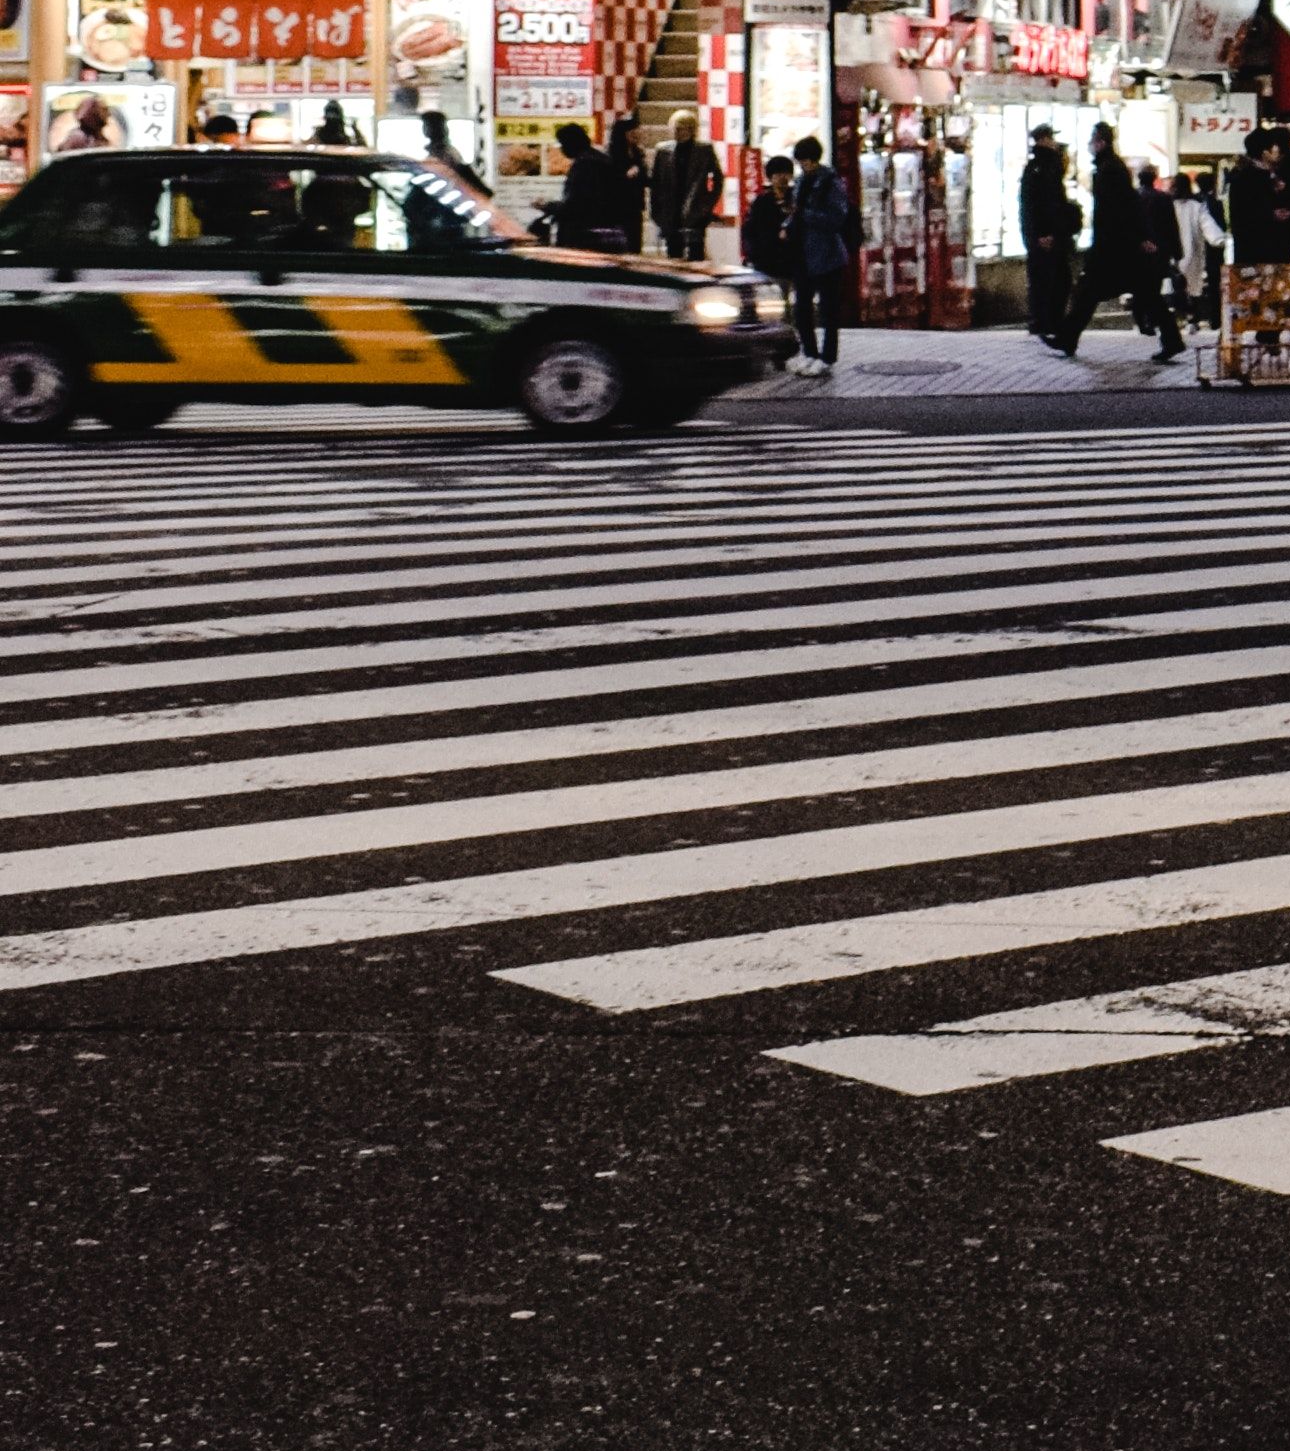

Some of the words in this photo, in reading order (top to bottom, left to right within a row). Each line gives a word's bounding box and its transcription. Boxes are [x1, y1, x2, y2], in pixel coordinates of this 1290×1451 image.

[158, 5, 363, 50] とらそば
[1189, 116, 1252, 133] トラノコ
